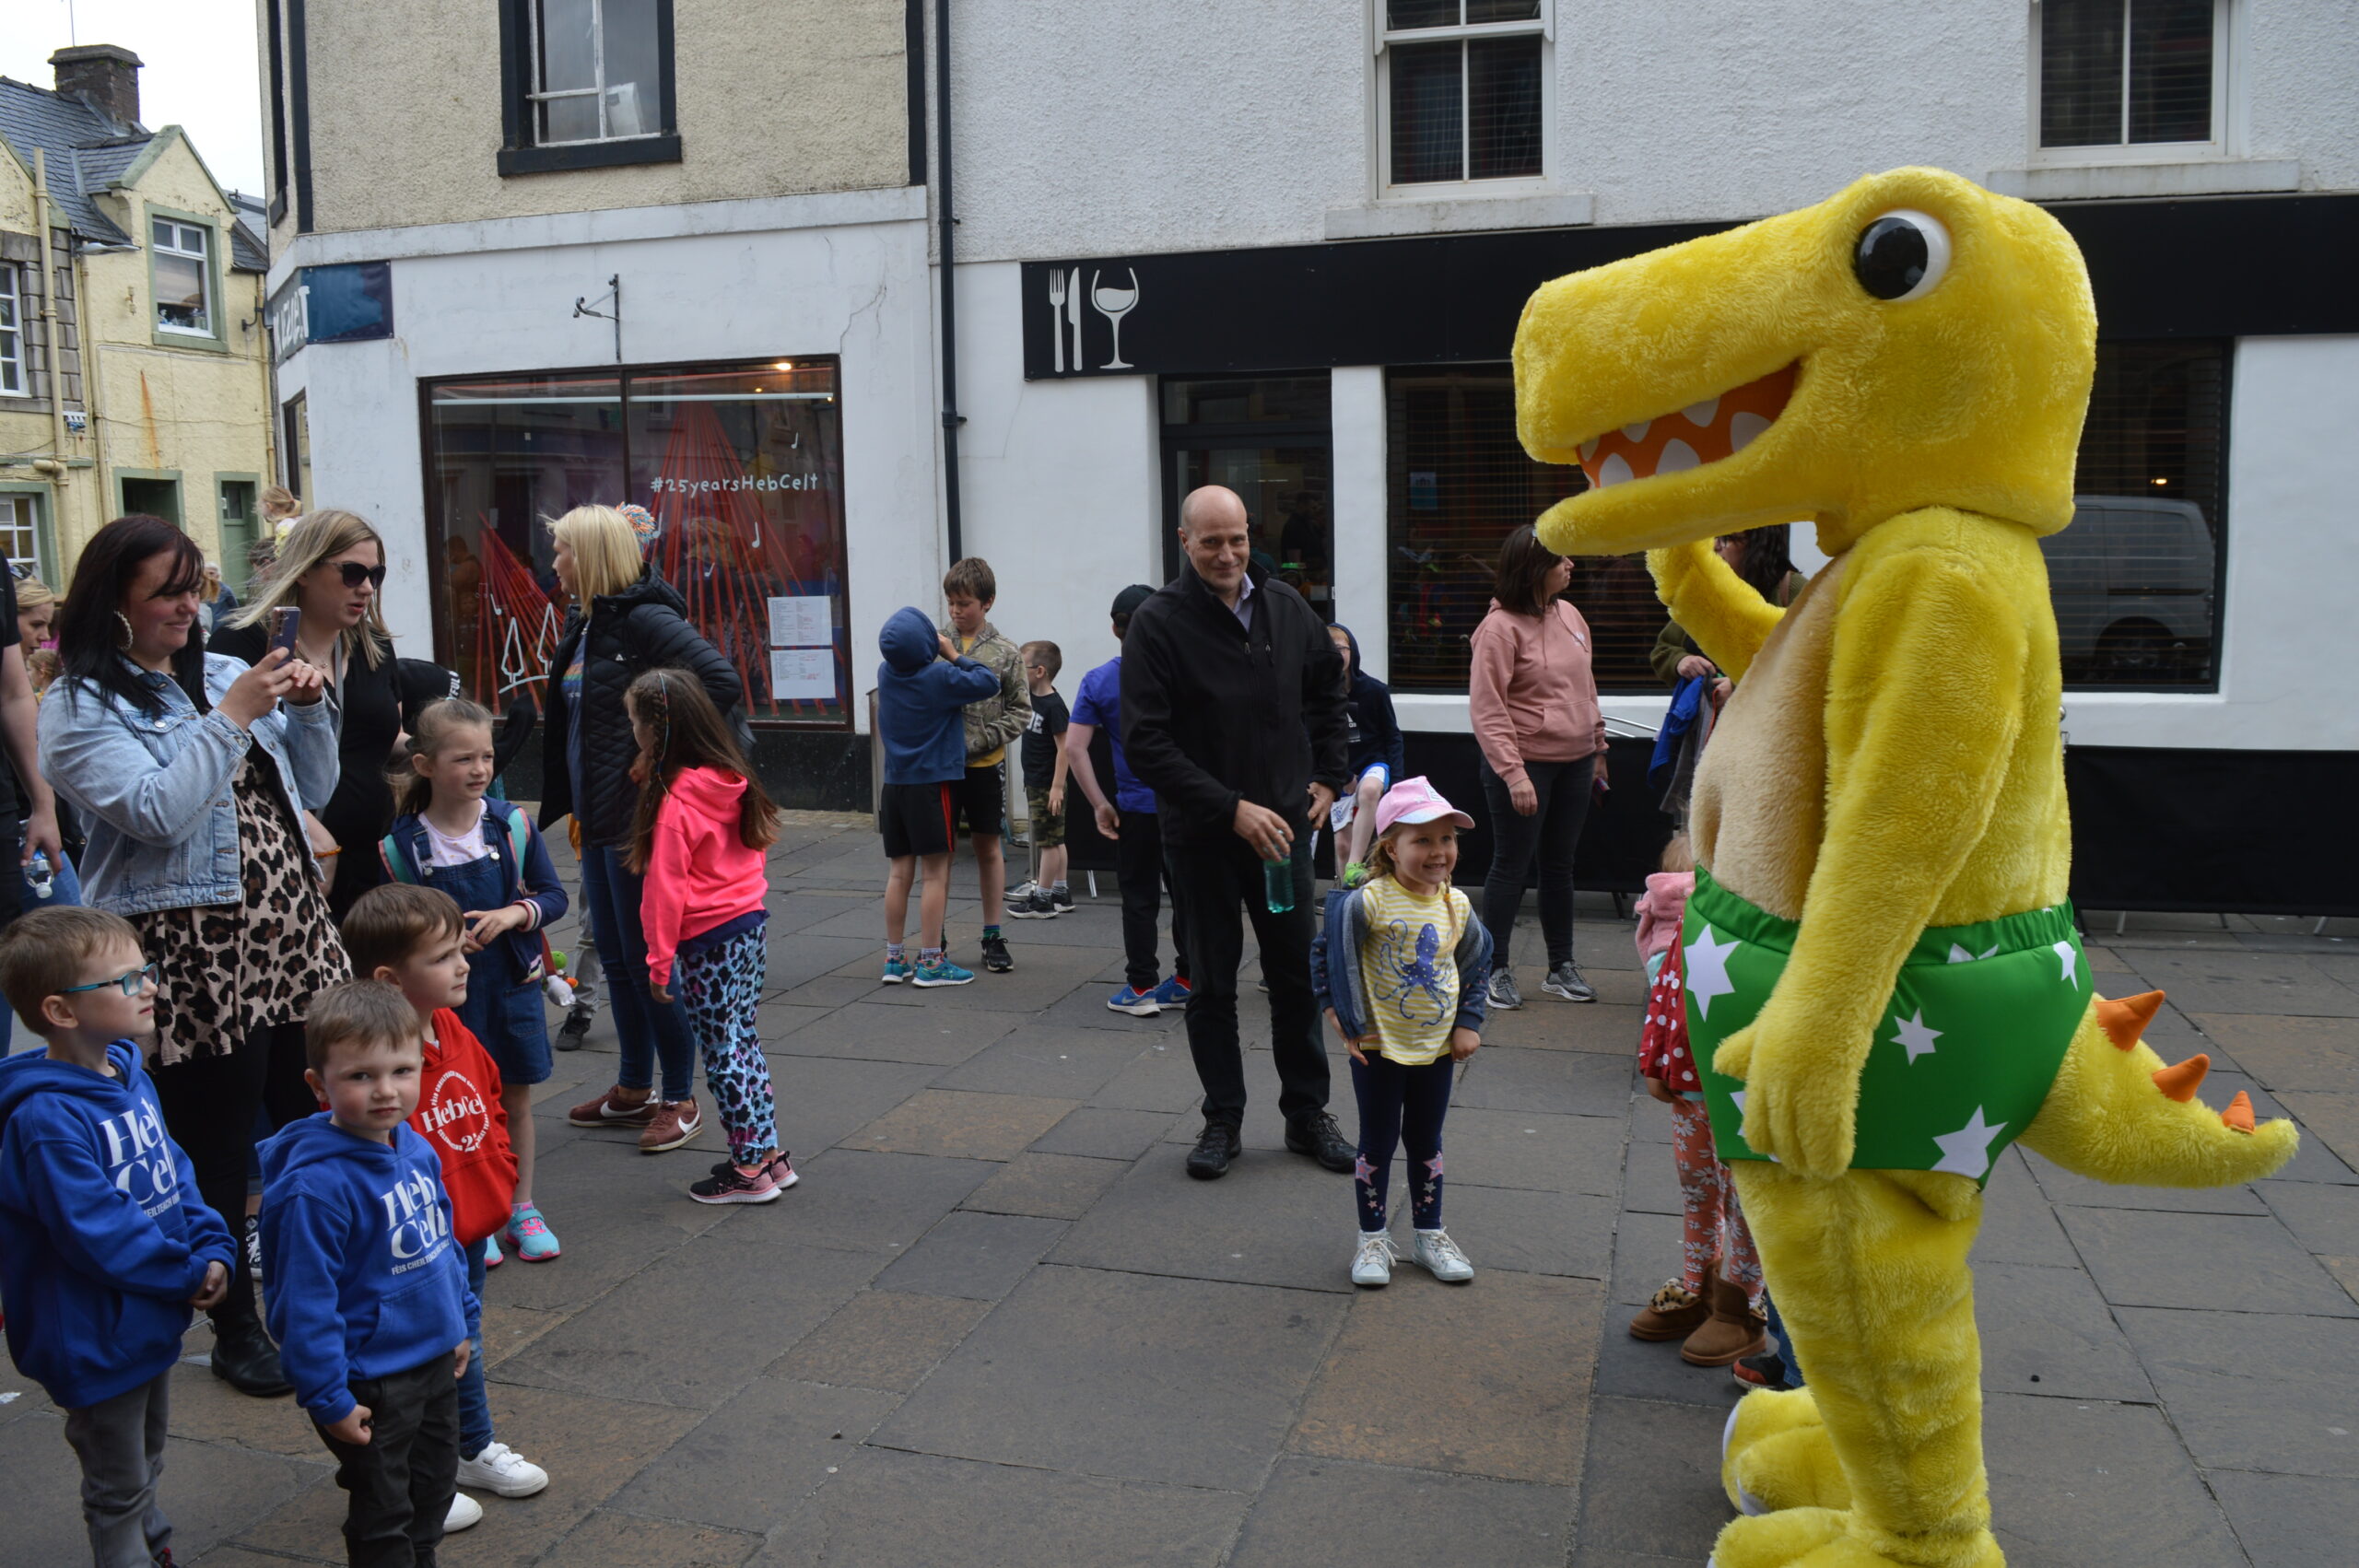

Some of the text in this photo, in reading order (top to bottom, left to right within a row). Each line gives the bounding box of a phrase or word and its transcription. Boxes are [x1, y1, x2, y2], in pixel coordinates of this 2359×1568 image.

[650, 473, 818, 498] #25yearsHebCelt
[100, 1096, 164, 1168] Heb
[380, 1169, 437, 1231] Heb
[391, 1202, 450, 1259] Celt
